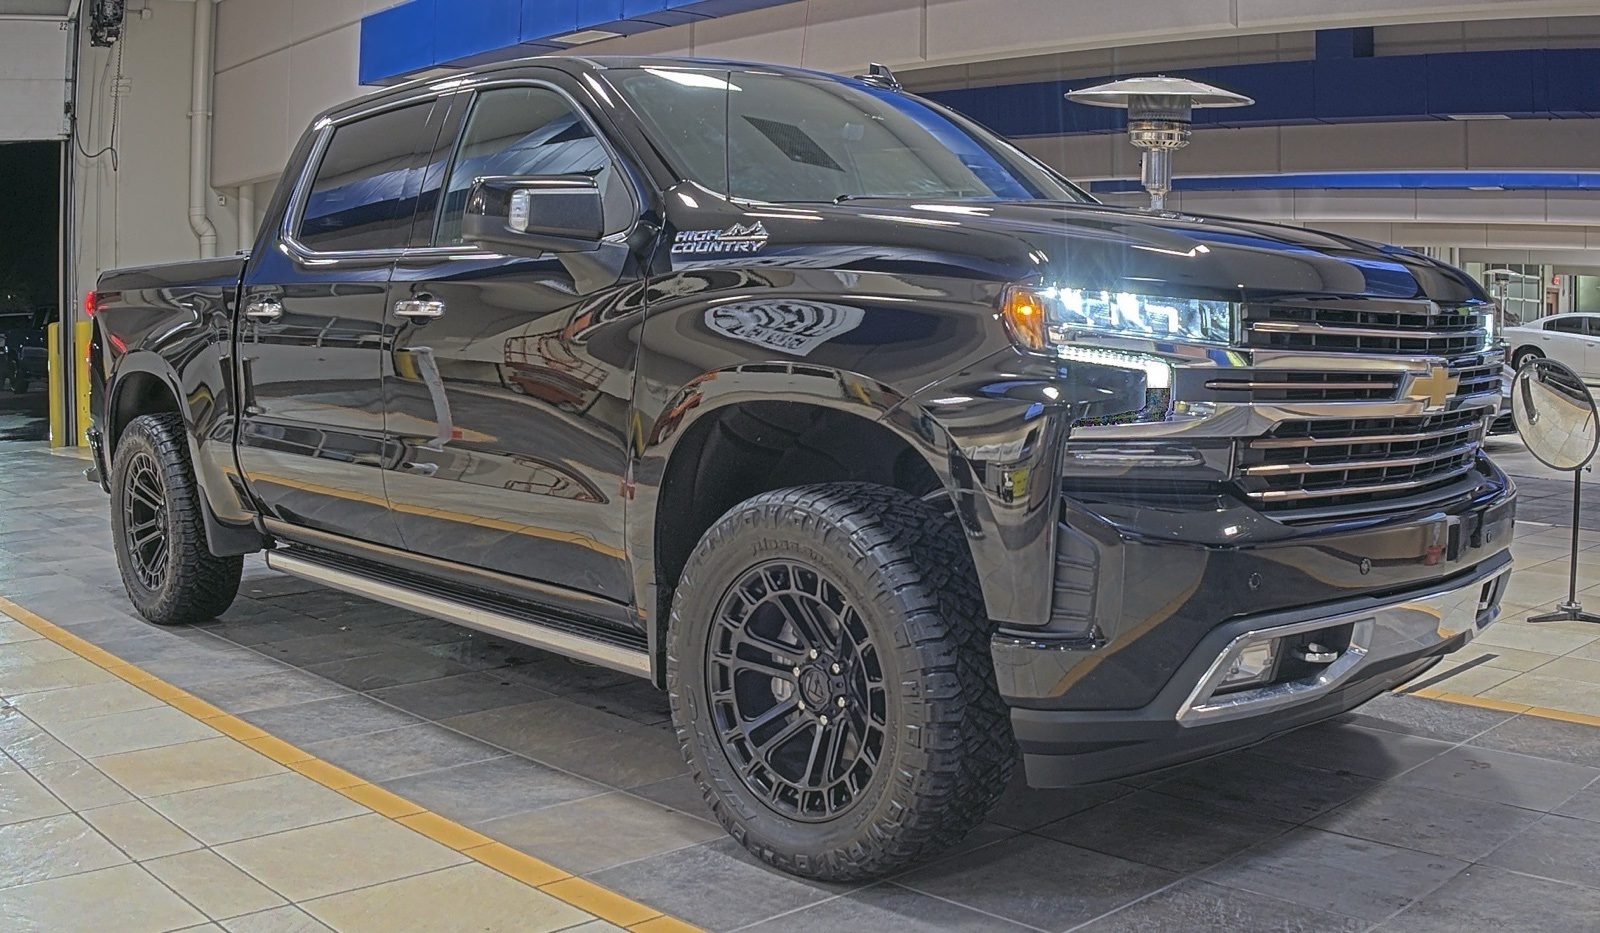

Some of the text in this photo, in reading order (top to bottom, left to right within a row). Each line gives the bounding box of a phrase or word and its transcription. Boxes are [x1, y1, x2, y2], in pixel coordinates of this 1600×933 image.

[59, 22, 68, 31] 22
[674, 229, 722, 242] HIGH
[671, 240, 766, 253] COUNTRY
